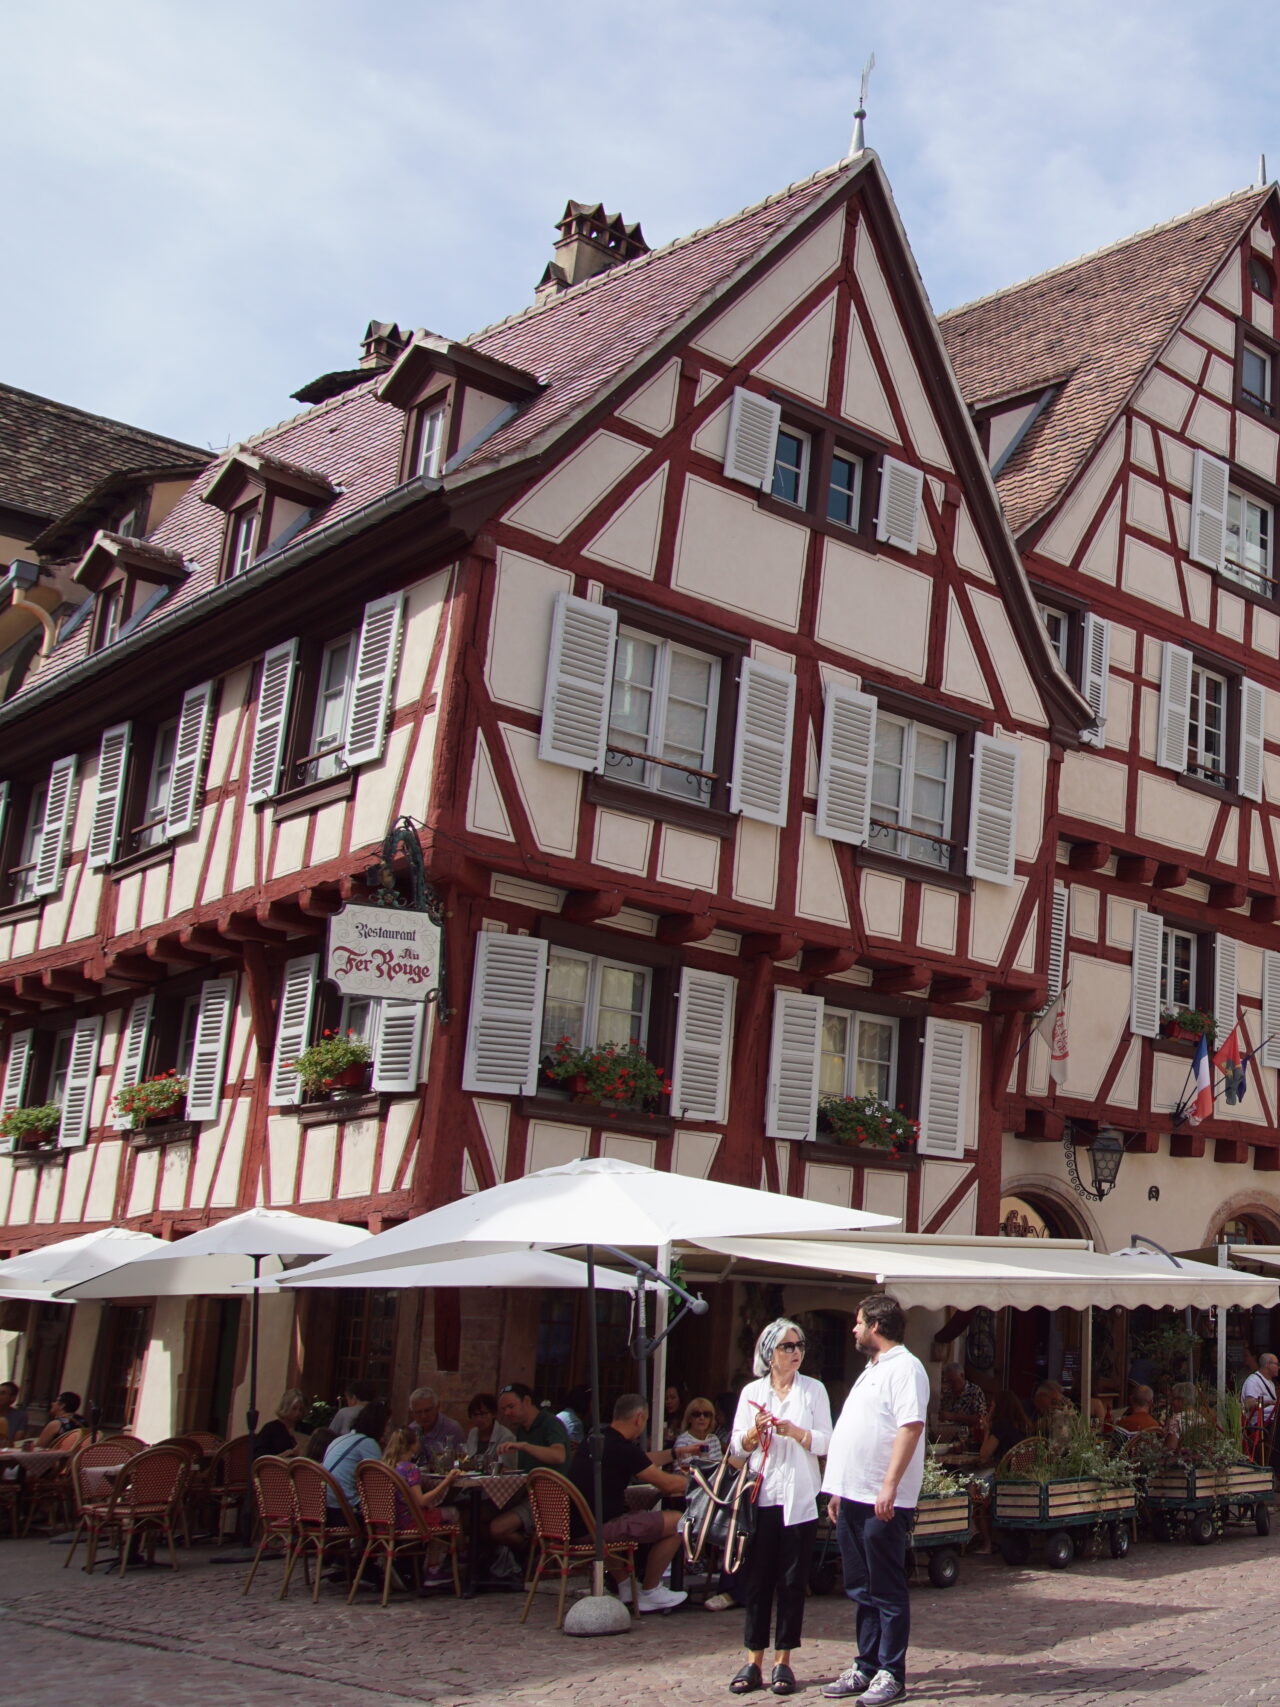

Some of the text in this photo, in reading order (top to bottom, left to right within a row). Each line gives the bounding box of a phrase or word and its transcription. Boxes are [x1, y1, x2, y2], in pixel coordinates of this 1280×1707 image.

[355, 922, 416, 941] Restaurant
[399, 948, 420, 960] Au
[332, 945, 430, 984] Fer Rouge
